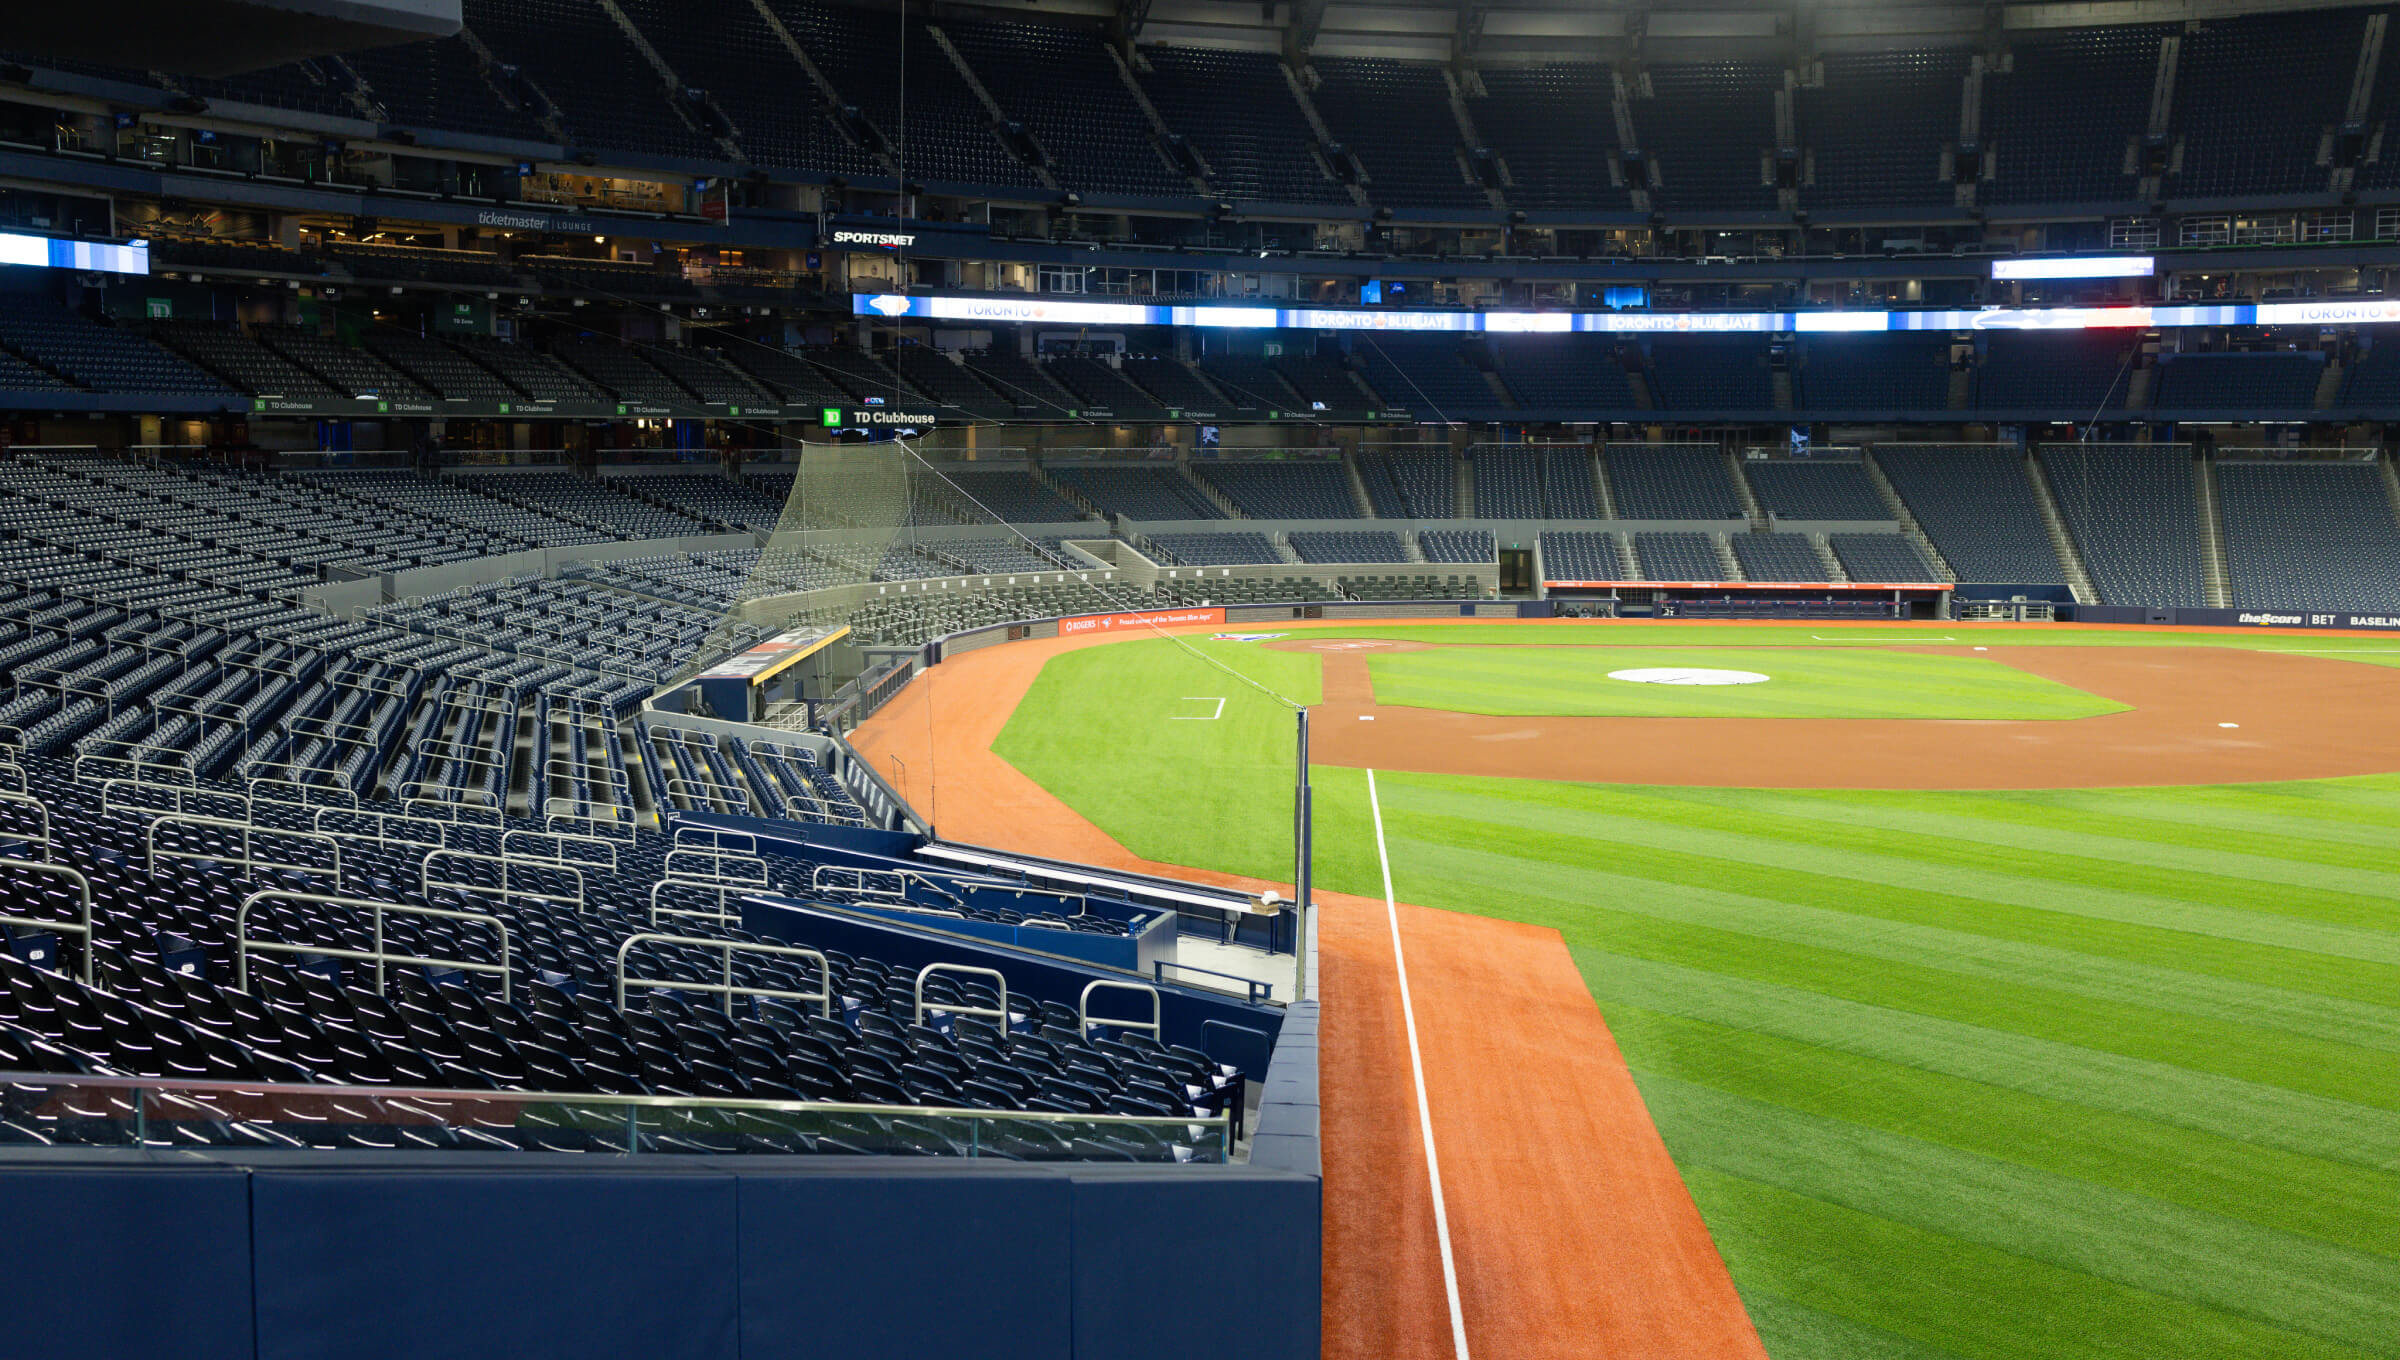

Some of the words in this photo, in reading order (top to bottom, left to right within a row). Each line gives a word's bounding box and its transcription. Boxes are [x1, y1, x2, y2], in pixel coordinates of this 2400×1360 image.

[478, 211, 546, 229] ticketmaster
[557, 221, 592, 232] LOUNGE
[833, 231, 916, 247] SPORTSNET
[149, 303, 170, 318] TD
[967, 303, 1031, 317] TORONTO
[2299, 306, 2382, 320] TORONTO
[1310, 313, 1372, 326] TORONTO
[1388, 315, 1417, 328] BLUE
[1421, 315, 1451, 328] JAYS
[1608, 316, 1673, 329] TORONTO
[1691, 316, 1721, 329] BLUE
[1724, 316, 1759, 329] JAYS
[1264, 343, 1281, 356] TD
[404, 403, 432, 411] Clubhouse
[641, 406, 671, 414] Clubhouse
[825, 411, 840, 423] TD
[853, 411, 871, 423] TD
[872, 411, 935, 424] Clubhouse
[1073, 619, 1096, 630] ROGERS
[2238, 612, 2302, 625] theScore
[2311, 614, 2336, 625] BET
